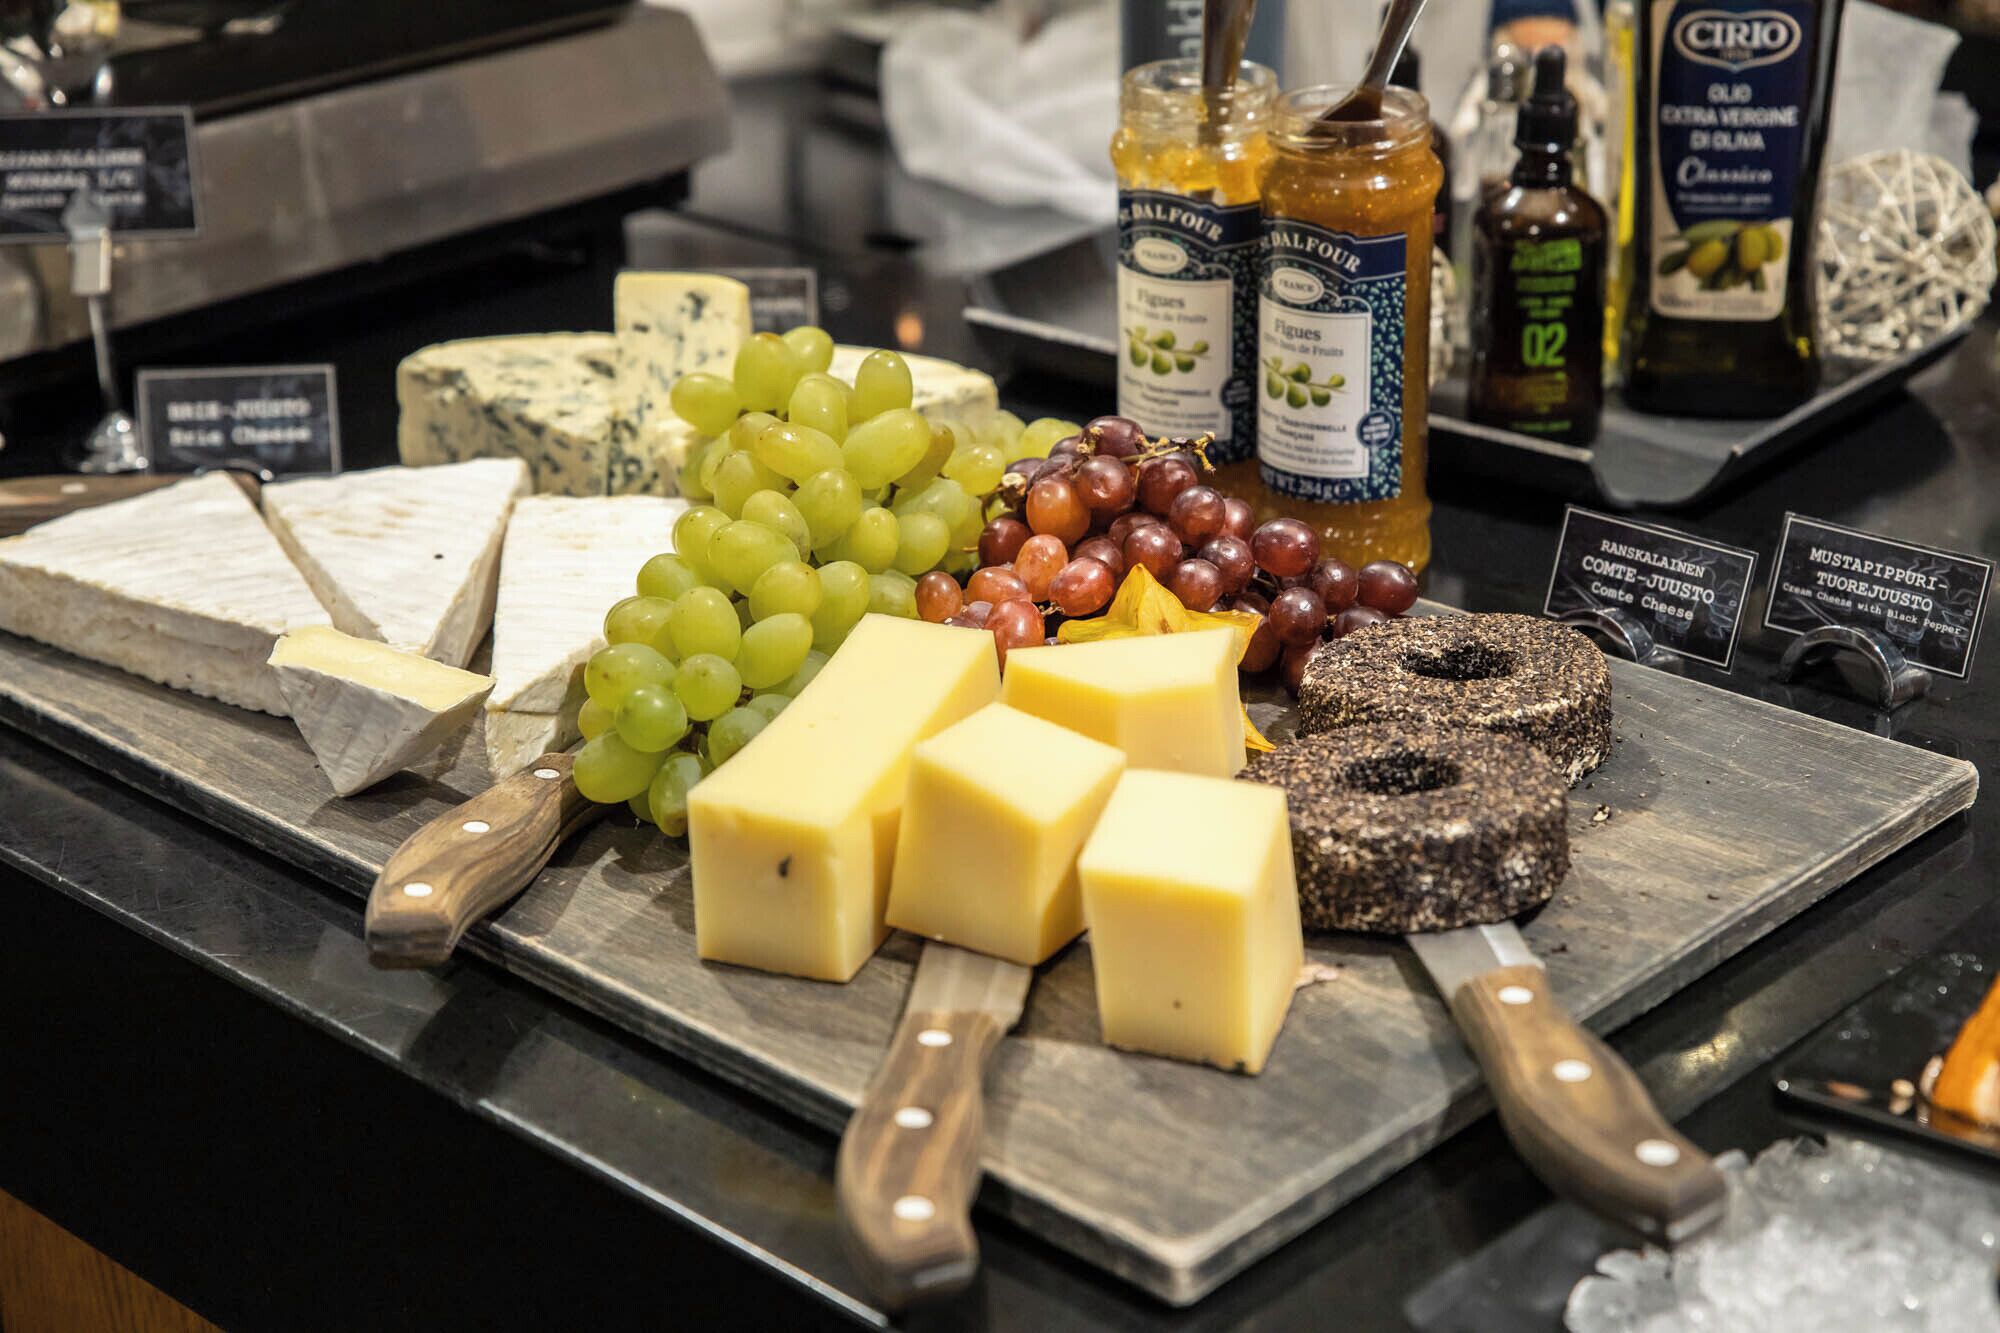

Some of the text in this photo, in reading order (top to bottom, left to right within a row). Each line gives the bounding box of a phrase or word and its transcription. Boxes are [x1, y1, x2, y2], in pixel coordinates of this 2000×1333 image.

[1685, 20, 1789, 49] CIRIO
[1708, 83, 1752, 104] OLIO
[1661, 105, 1798, 127] EXTRA VERGINE
[1690, 130, 1765, 150] DI OLIVA
[1132, 203, 1223, 241] DALFOUR
[1271, 231, 1361, 273] DALFOUR
[1275, 319, 1321, 340] Figues
[1522, 323, 1567, 367] 02
[1601, 540, 1705, 578] RANSKALAINEN
[1809, 547, 1948, 590] MUSTAPIPPURI-
[1582, 555, 1715, 604] COMTE-JUUSTO
[1817, 571, 1933, 611] TUOREJUUSTO
[1591, 582, 1694, 620] Comte Cheese
[1782, 582, 1962, 635] Cream Cheese with Black Pepper
